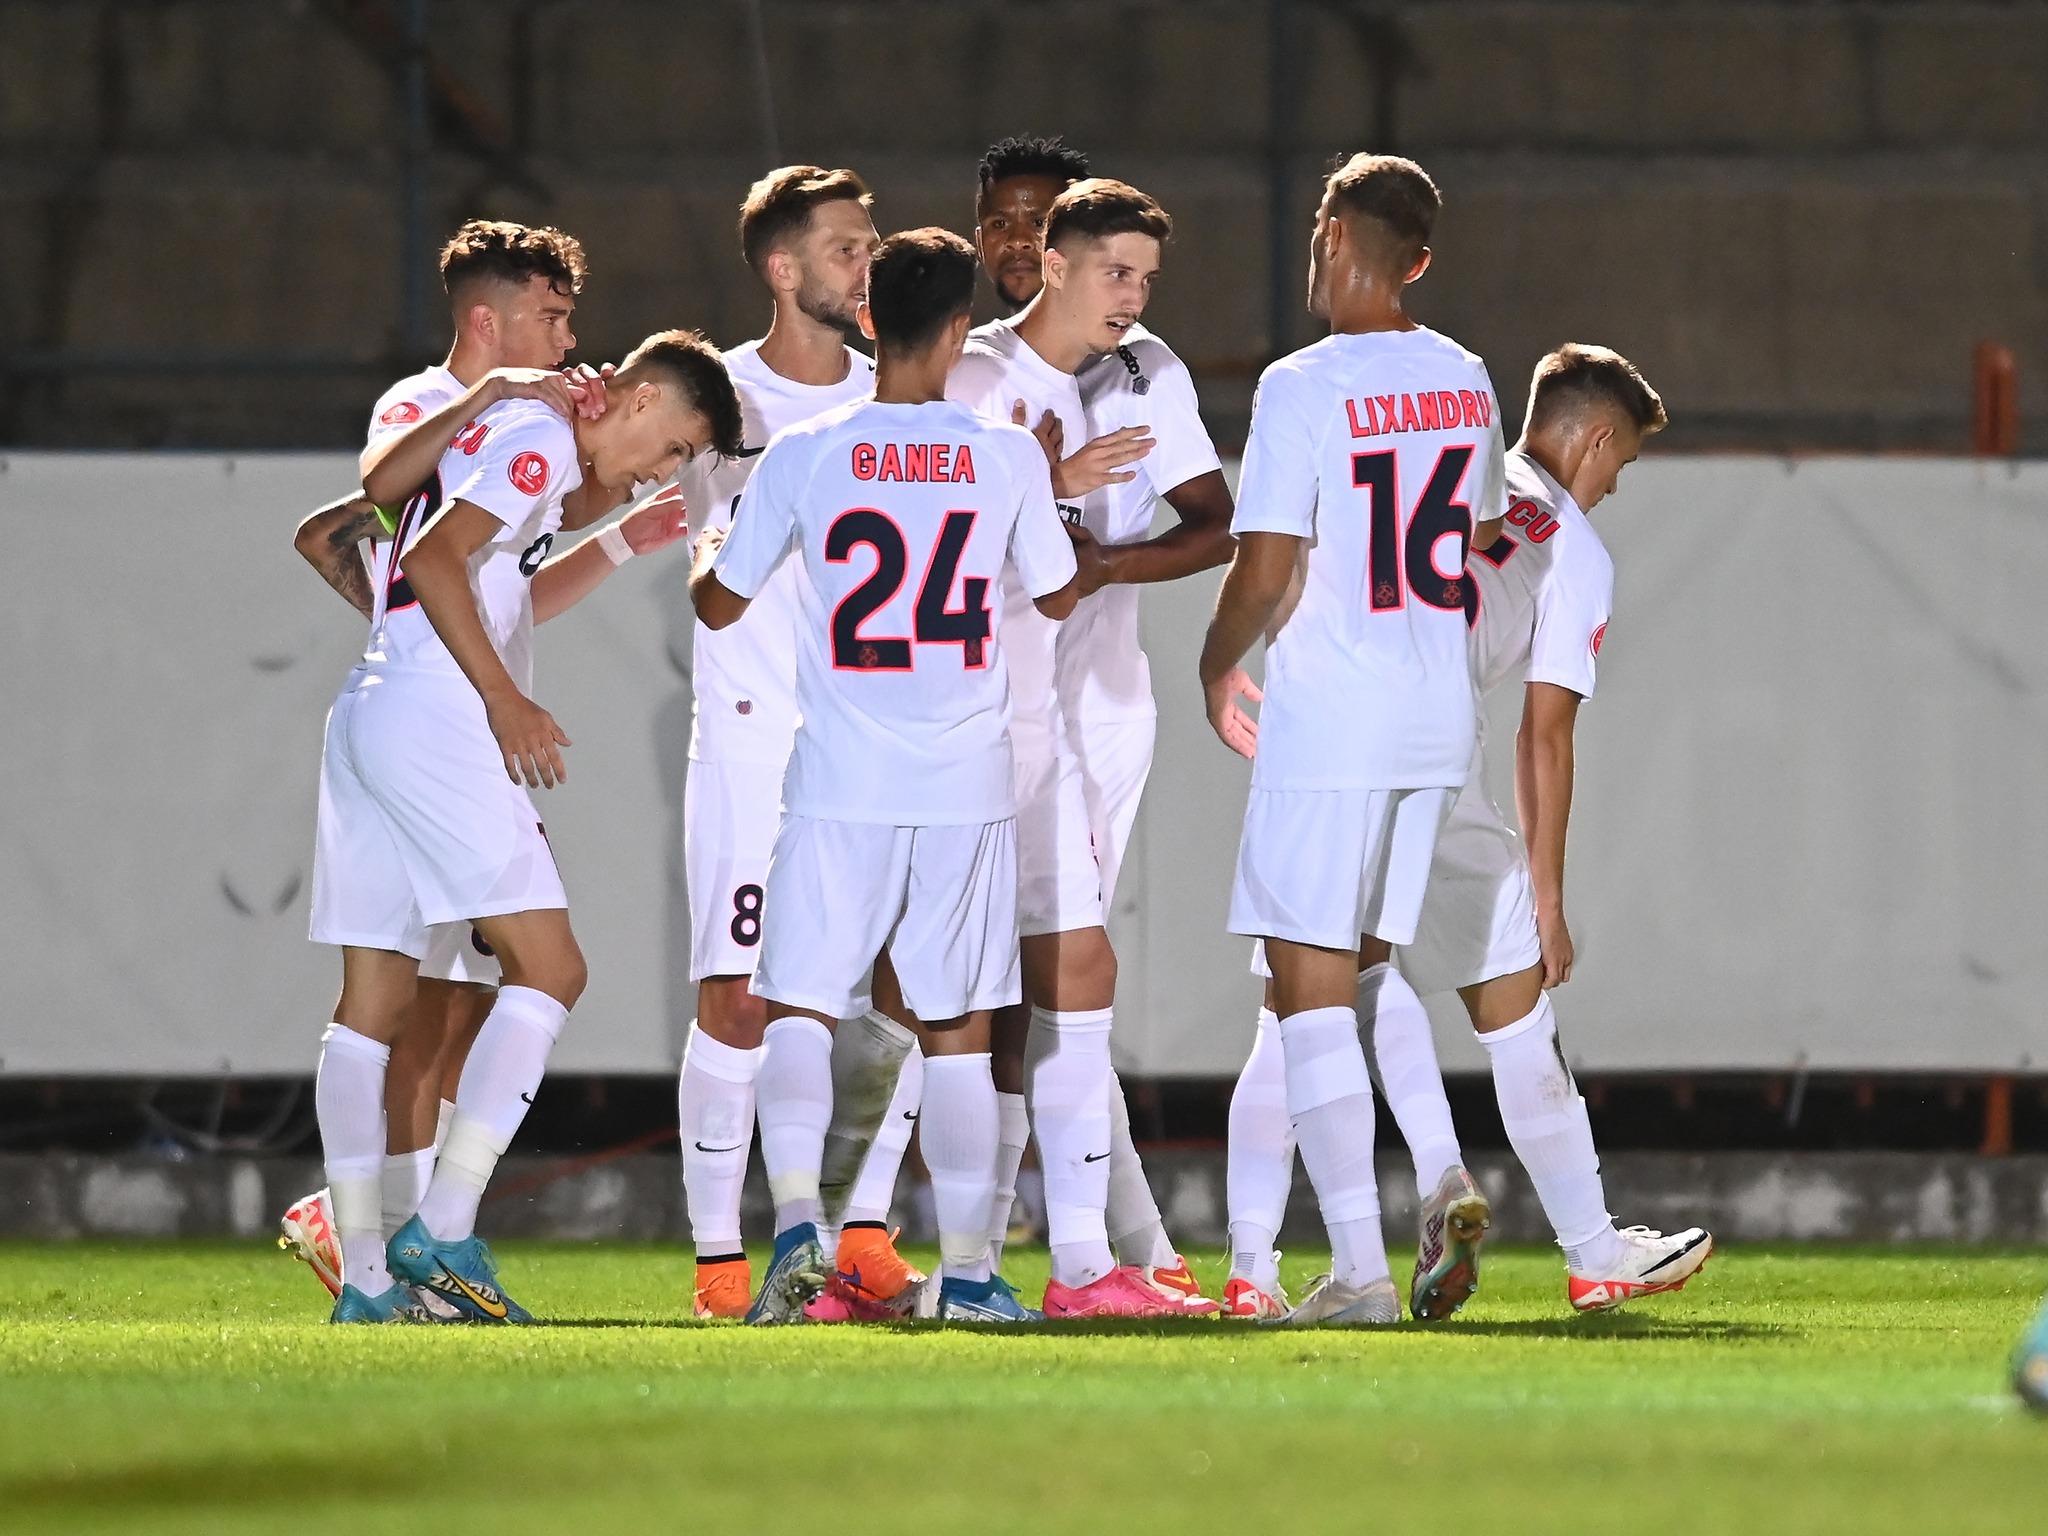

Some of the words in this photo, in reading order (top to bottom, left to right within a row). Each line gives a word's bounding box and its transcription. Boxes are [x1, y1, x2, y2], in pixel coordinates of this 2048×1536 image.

[851, 442, 976, 484] GANEA
[1350, 443, 1473, 613] 16
[1504, 493, 1562, 544] CU
[824, 507, 993, 672] 24
[730, 884, 764, 948] 8
